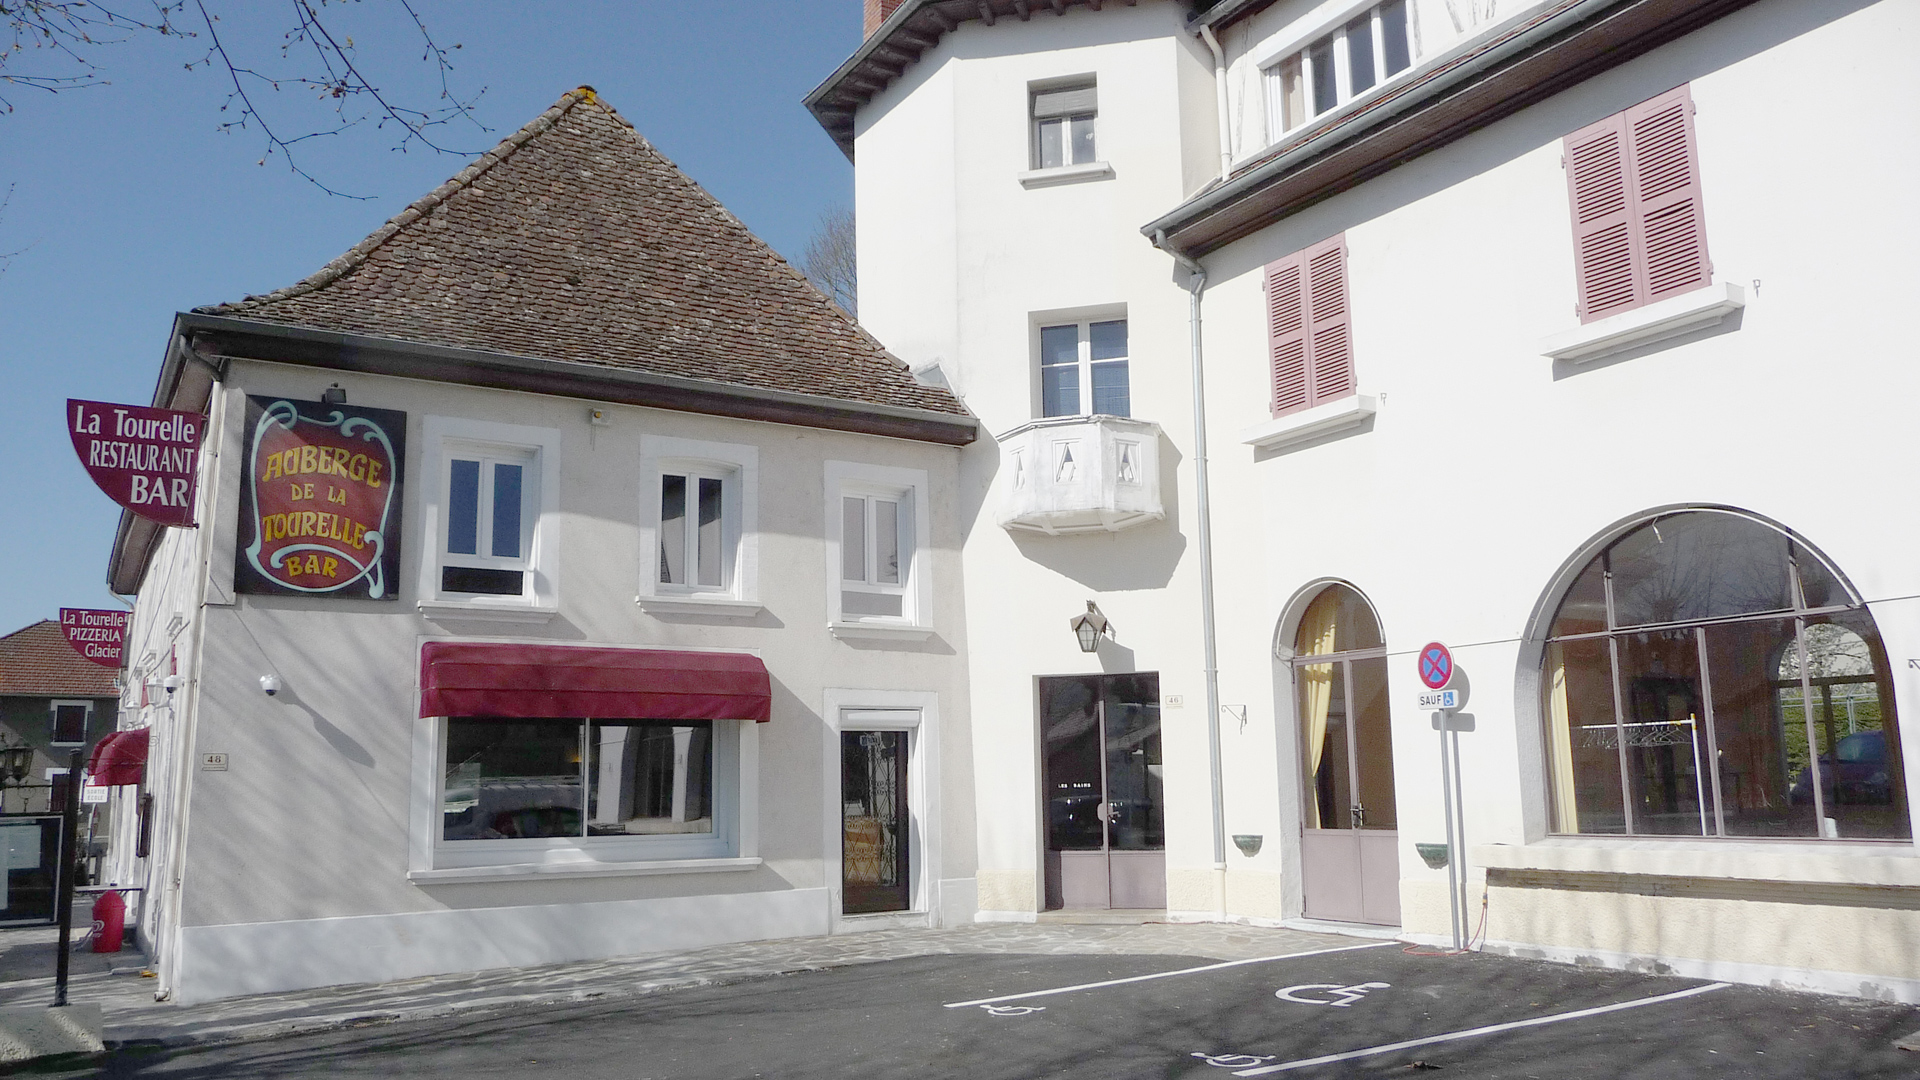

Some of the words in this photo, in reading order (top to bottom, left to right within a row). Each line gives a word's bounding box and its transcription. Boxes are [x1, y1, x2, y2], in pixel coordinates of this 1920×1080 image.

[75, 405, 101, 435] La
[114, 409, 195, 443] Tourelle
[89, 439, 195, 474] RESTAURANT
[262, 445, 382, 488] AUBERGE
[130, 474, 189, 508] BAR
[290, 483, 315, 501] DE
[327, 485, 347, 506] LA
[262, 511, 367, 550] TOURELLE
[285, 554, 339, 578] BAR
[63, 609, 76, 625] La
[79, 611, 124, 627] Tourelle
[69, 627, 121, 643] PIZZERIA
[85, 643, 121, 659] Glacier
[1420, 694, 1442, 706] SAUF
[207, 755, 222, 764] 48
